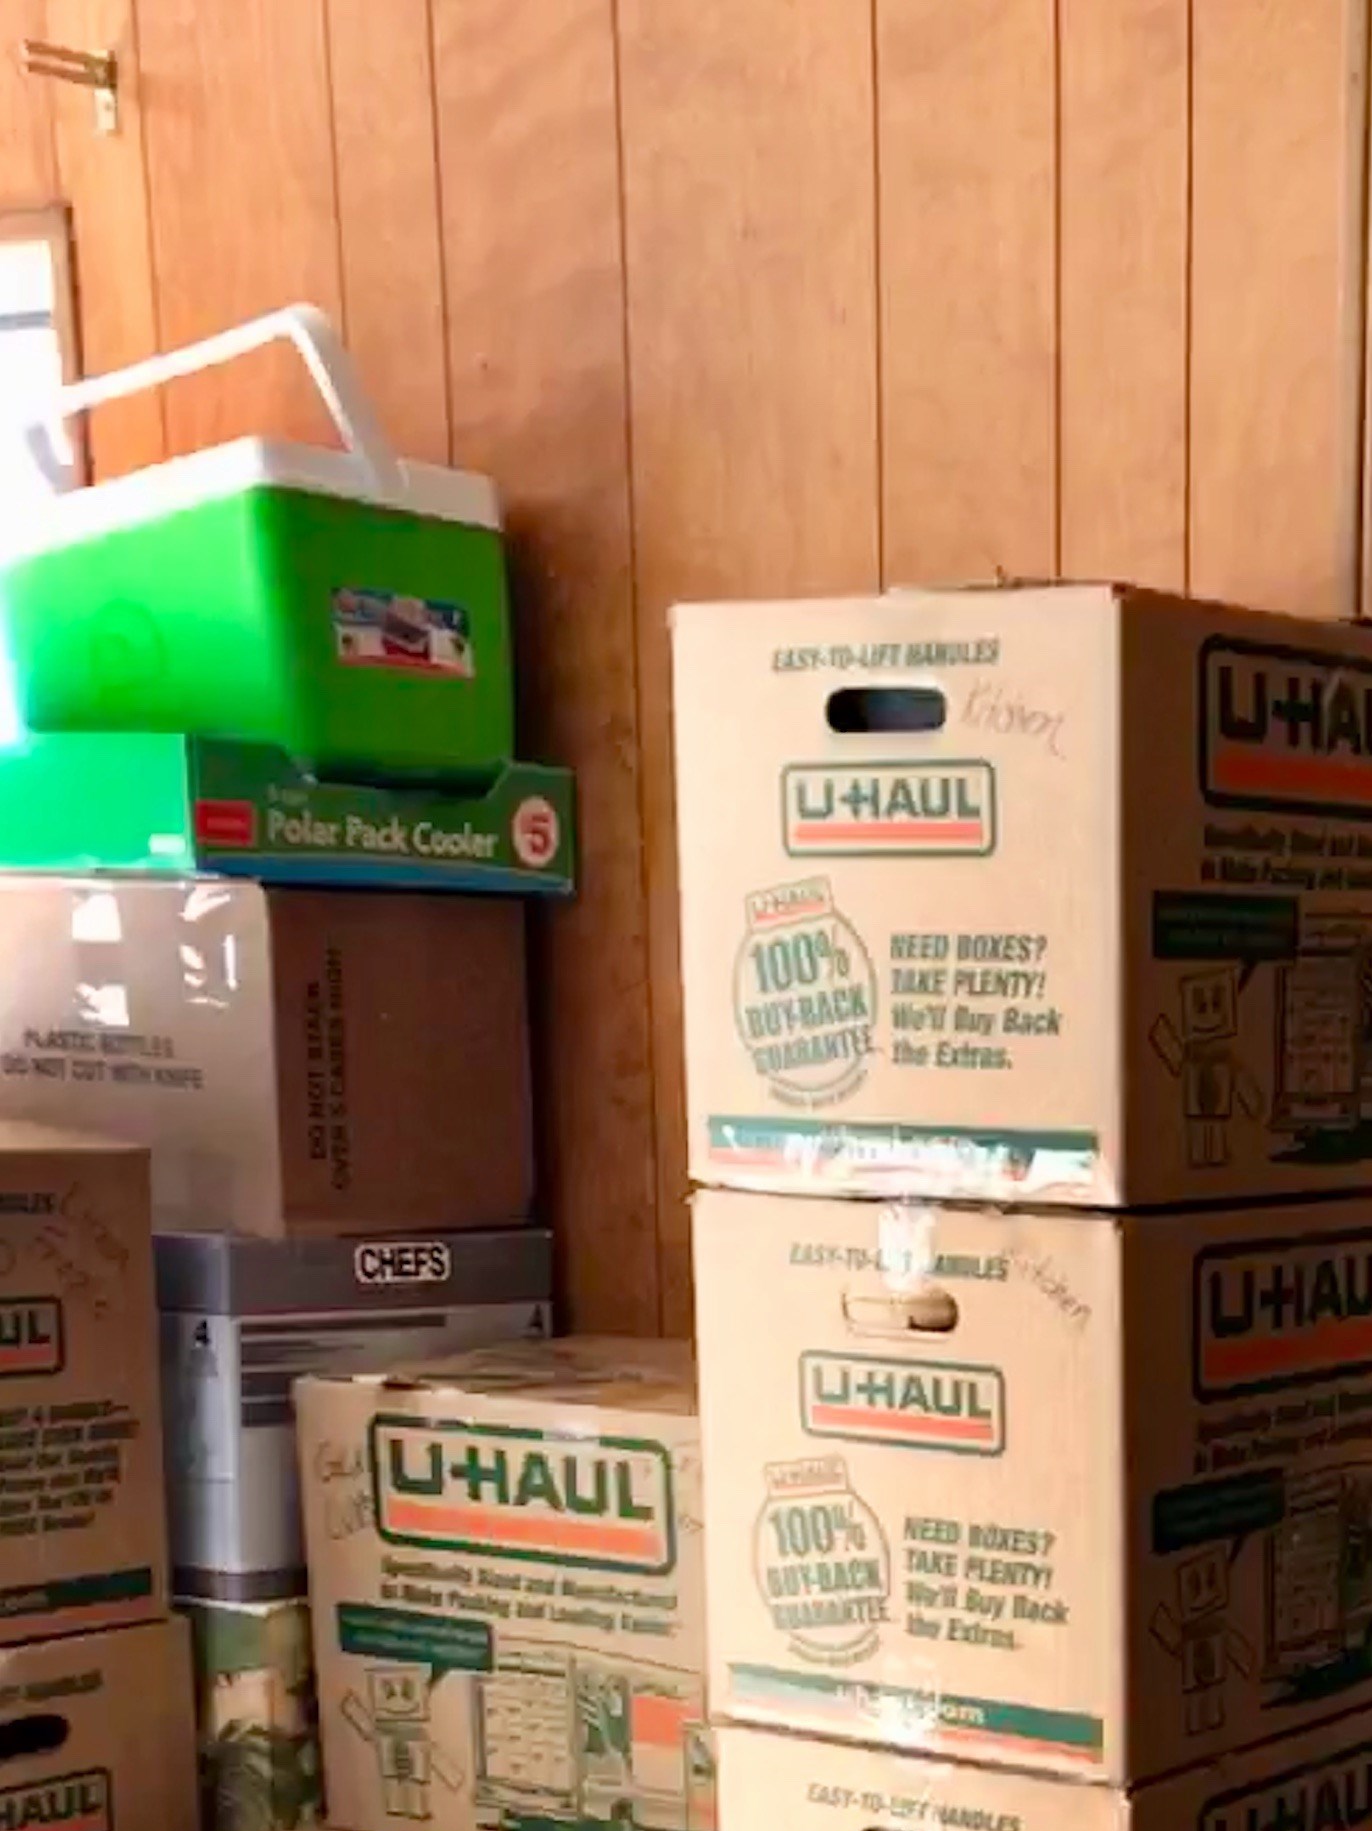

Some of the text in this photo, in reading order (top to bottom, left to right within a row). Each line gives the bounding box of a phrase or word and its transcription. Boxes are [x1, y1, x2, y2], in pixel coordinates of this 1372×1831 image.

[772, 637, 1002, 673] EASY-TO-LIFT HANDLES
[797, 777, 981, 820] U-HAUL
[266, 808, 499, 859] Polar Pack Cooler
[526, 815, 553, 856] 5
[750, 930, 849, 994] 100%
[891, 934, 1048, 962] NEED BOXES?
[891, 969, 1046, 998] TAKE PLENTY!
[745, 997, 868, 1040] BUY-BACK
[954, 1007, 995, 1037] Buy
[1002, 1007, 1064, 1036] Back
[892, 1041, 1013, 1071] the Extras.
[359, 1246, 447, 1279] CHEFS
[789, 1242, 912, 1273] EASY-TO-LT
[812, 1365, 992, 1420] U-HAUL
[388, 1438, 654, 1521] U-HAUL
[769, 1502, 866, 1558] 100%
[904, 1516, 1056, 1557] NEED BOXES?
[766, 1558, 880, 1597] BUY-BACK
[906, 1548, 1052, 1590] TAKE PLENTY!
[965, 1589, 1004, 1619] Buy
[1013, 1594, 1069, 1625] Back
[907, 1615, 1024, 1652] the Extras.
[806, 1781, 929, 1821] EASY-TO-LIFT
